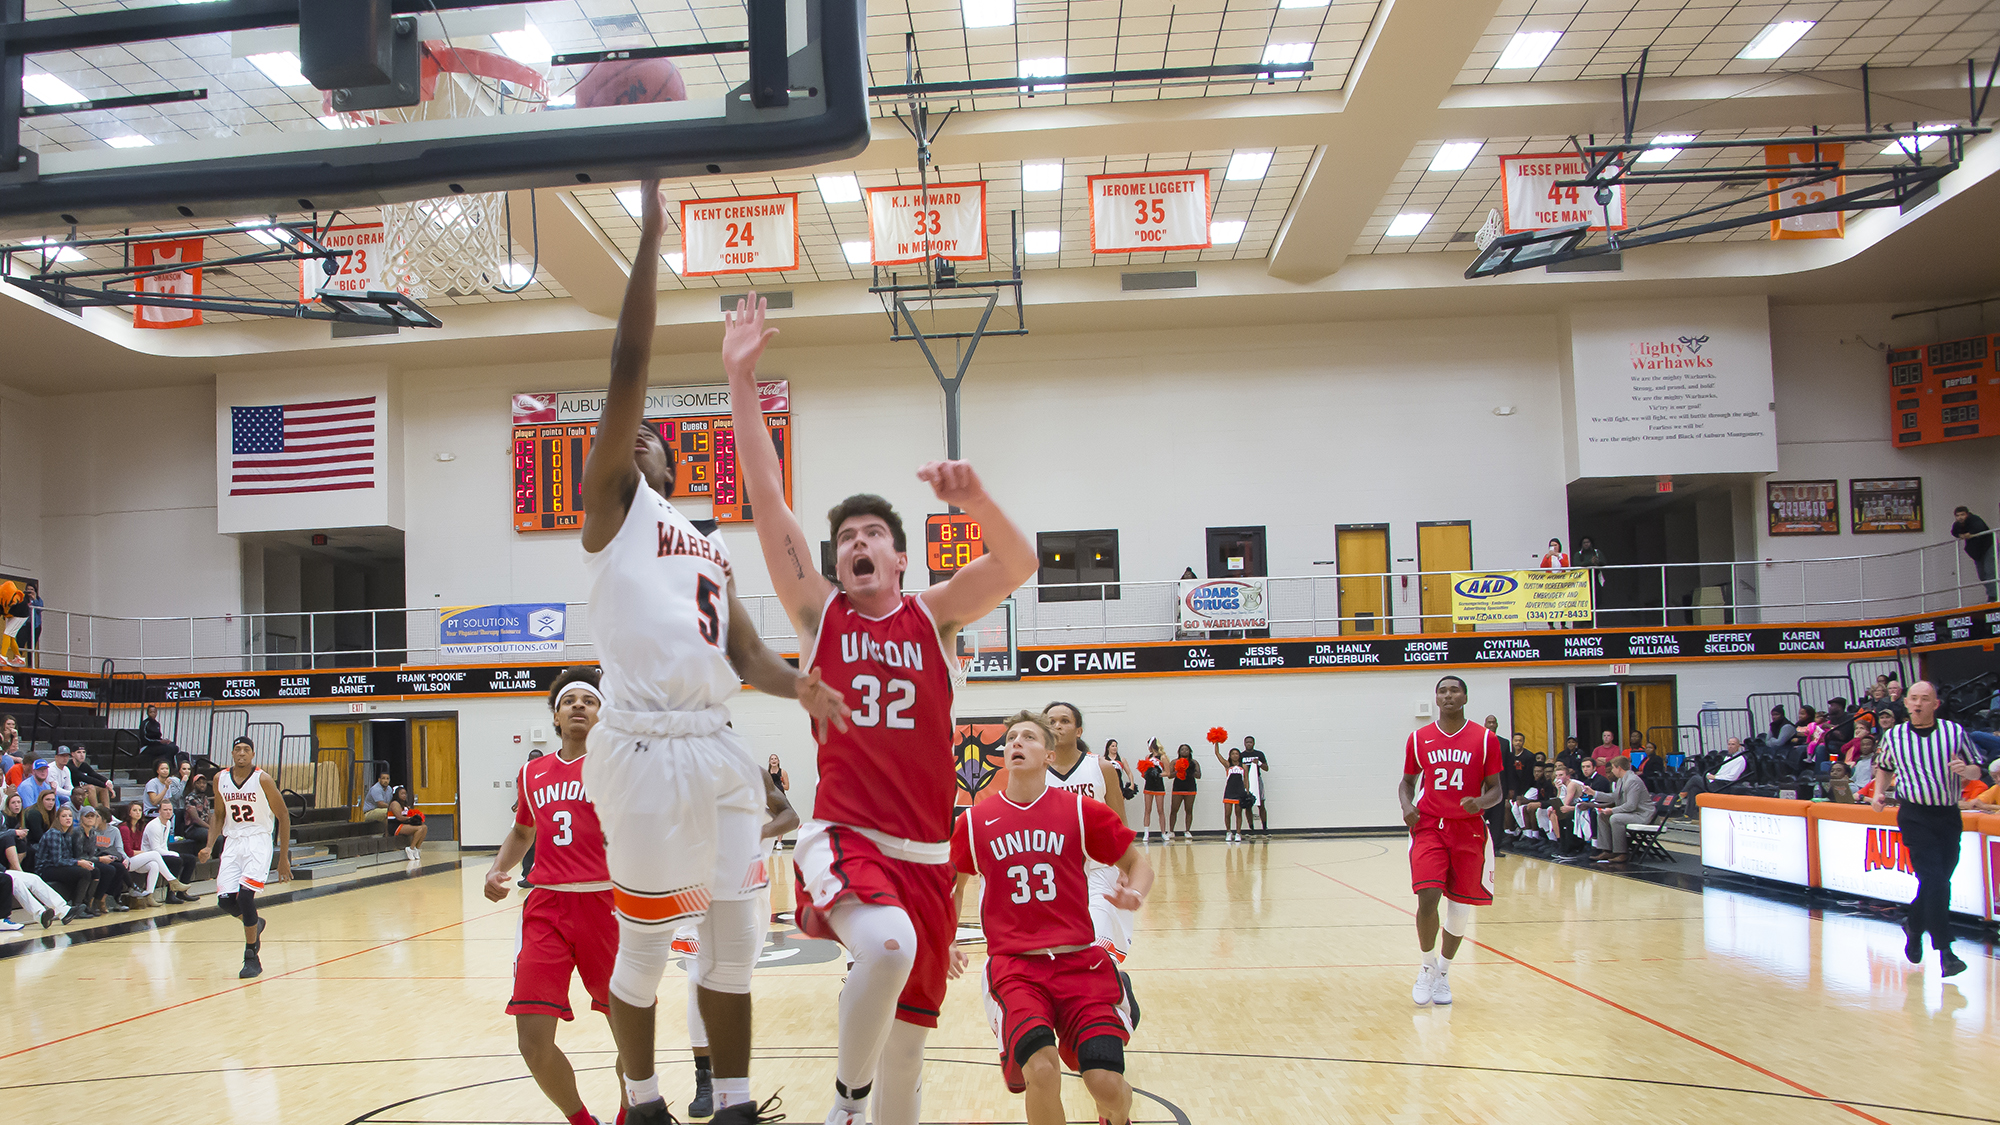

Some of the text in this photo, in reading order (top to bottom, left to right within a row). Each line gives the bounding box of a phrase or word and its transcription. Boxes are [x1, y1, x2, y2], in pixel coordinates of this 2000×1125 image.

[1518, 164, 1552, 177] JESSE
[1102, 180, 1196, 197] JEROME LIGGETT
[1547, 180, 1580, 205] 44
[892, 196, 910, 208] K.J.
[693, 203, 786, 221] KENT CRENSHAW
[1134, 198, 1166, 225] 35
[1535, 210, 1593, 224] "ICE MAN"
[913, 209, 942, 236] 33
[725, 221, 755, 248] 24
[1134, 229, 1167, 242] "DOC"
[897, 239, 958, 254] IN MEMORY
[339, 249, 368, 275] 23
[719, 251, 760, 265] "CHUB"
[334, 280, 357, 291] "BIG
[1630, 341, 1685, 358] Mighty
[1631, 355, 1714, 370] Warhawks
[644, 392, 732, 409] ONTGOMER
[541, 428, 563, 437] points
[692, 432, 709, 452] 13
[695, 465, 705, 480] 5
[553, 498, 563, 512] 6
[940, 522, 982, 542] 8:10
[1467, 579, 1506, 594] AKD
[1193, 587, 1239, 599] ADAMS
[696, 572, 721, 649] 5
[1193, 599, 1241, 611] DRUGS
[1526, 609, 1589, 620] (334) 277-8433
[448, 617, 520, 628] PT SOLUTIONS
[1183, 618, 1266, 629] GO WARHAWKS
[1705, 632, 1753, 643] JEFFREY
[1782, 631, 1821, 641] KAREN
[1859, 626, 1901, 639] HJORTUR
[1483, 639, 1531, 649] CYNTHIA
[1564, 636, 1603, 647] NANCY
[1629, 634, 1678, 645] CRYSTAL
[1844, 636, 1907, 650] HJARTARSSON
[446, 643, 558, 654] WWW.PTSOLUTIONS.COM
[1245, 646, 1279, 656] JESSE
[1315, 643, 1372, 654] DR. HANLY
[1404, 641, 1449, 651] JEROME
[1628, 645, 1680, 656] WILLIAMS
[1704, 643, 1756, 654] SKELDON
[1779, 640, 1826, 651] DUNCAN
[840, 631, 924, 672] UNION
[1188, 648, 1211, 658] Q.V.
[1404, 651, 1449, 662] LIGGETT
[1475, 649, 1540, 660] ALEXANDER
[1564, 647, 1604, 658] HARRIS
[1036, 653, 1067, 672] OF
[1074, 651, 1137, 671] FAME
[1183, 658, 1216, 669] LOWE
[1239, 656, 1285, 667] PHILLIPS
[1308, 653, 1380, 665] FUNDERBURK
[1613, 664, 1627, 674] EXIT
[339, 675, 367, 684] KATIE
[396, 672, 467, 683] FRANK "POOKIE"
[495, 670, 531, 680] DR. JIM
[31, 677, 50, 687] HEATH
[68, 680, 89, 689] MARTIN
[226, 679, 256, 688] PETER
[280, 677, 310, 687] ELLEN
[412, 682, 451, 692] WILSON
[489, 680, 537, 690] WILLIAMS
[33, 687, 49, 697] ZAPF
[61, 689, 96, 700] GUSTAVSSON
[222, 688, 260, 698] OLSSON
[331, 684, 376, 694] BARNETT
[850, 673, 917, 730] 32
[351, 703, 364, 713] EXIT
[1427, 748, 1472, 766] UNION
[1434, 768, 1464, 791] 24
[230, 804, 255, 823] 22
[552, 810, 573, 847] 3
[1738, 814, 1781, 836] AUBURN
[989, 829, 1065, 861] UNION
[1006, 862, 1058, 905] 33
